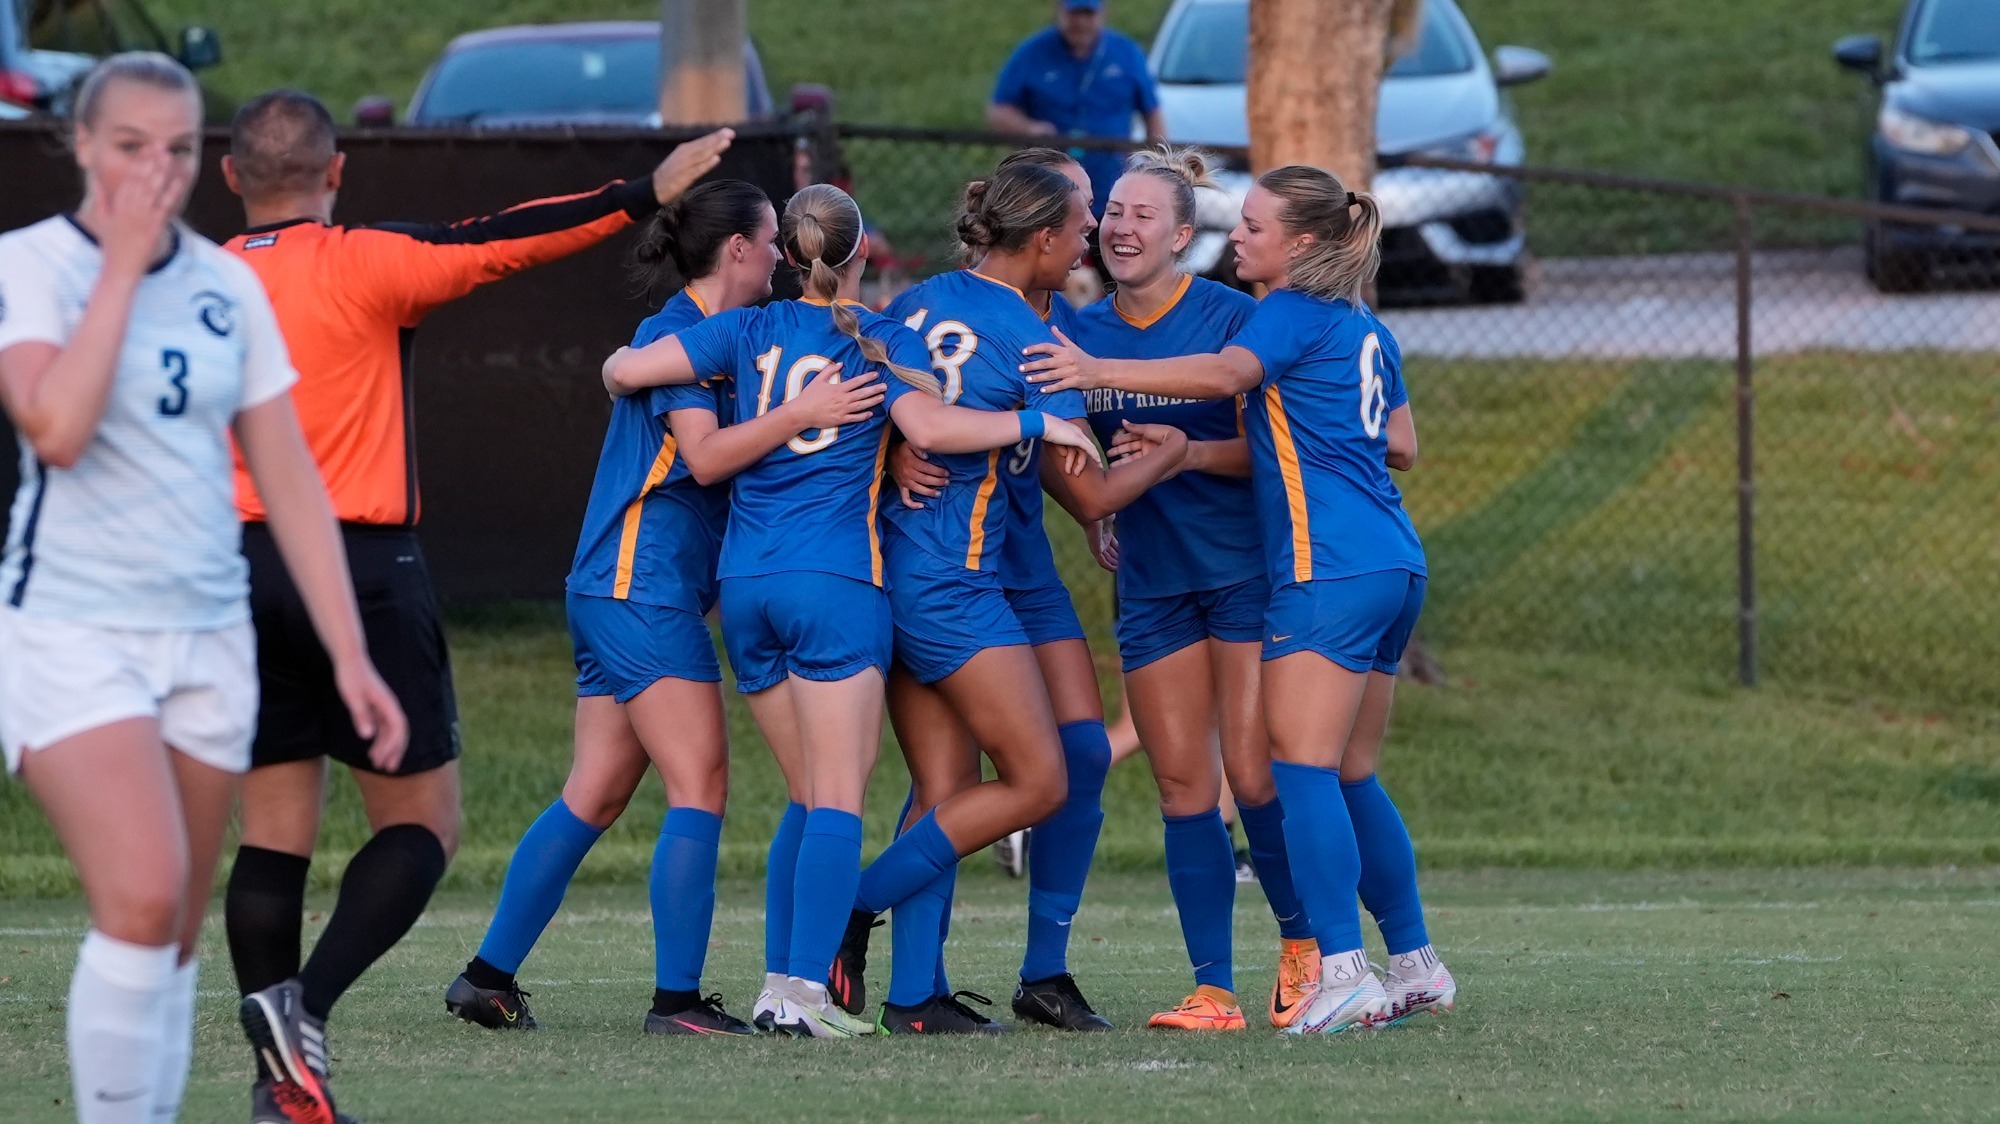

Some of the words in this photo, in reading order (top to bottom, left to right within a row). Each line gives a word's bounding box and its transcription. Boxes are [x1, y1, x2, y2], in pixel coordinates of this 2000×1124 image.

[160, 349, 189, 416] 3
[1359, 332, 1385, 440] 6
[1008, 437, 1035, 476] 9
